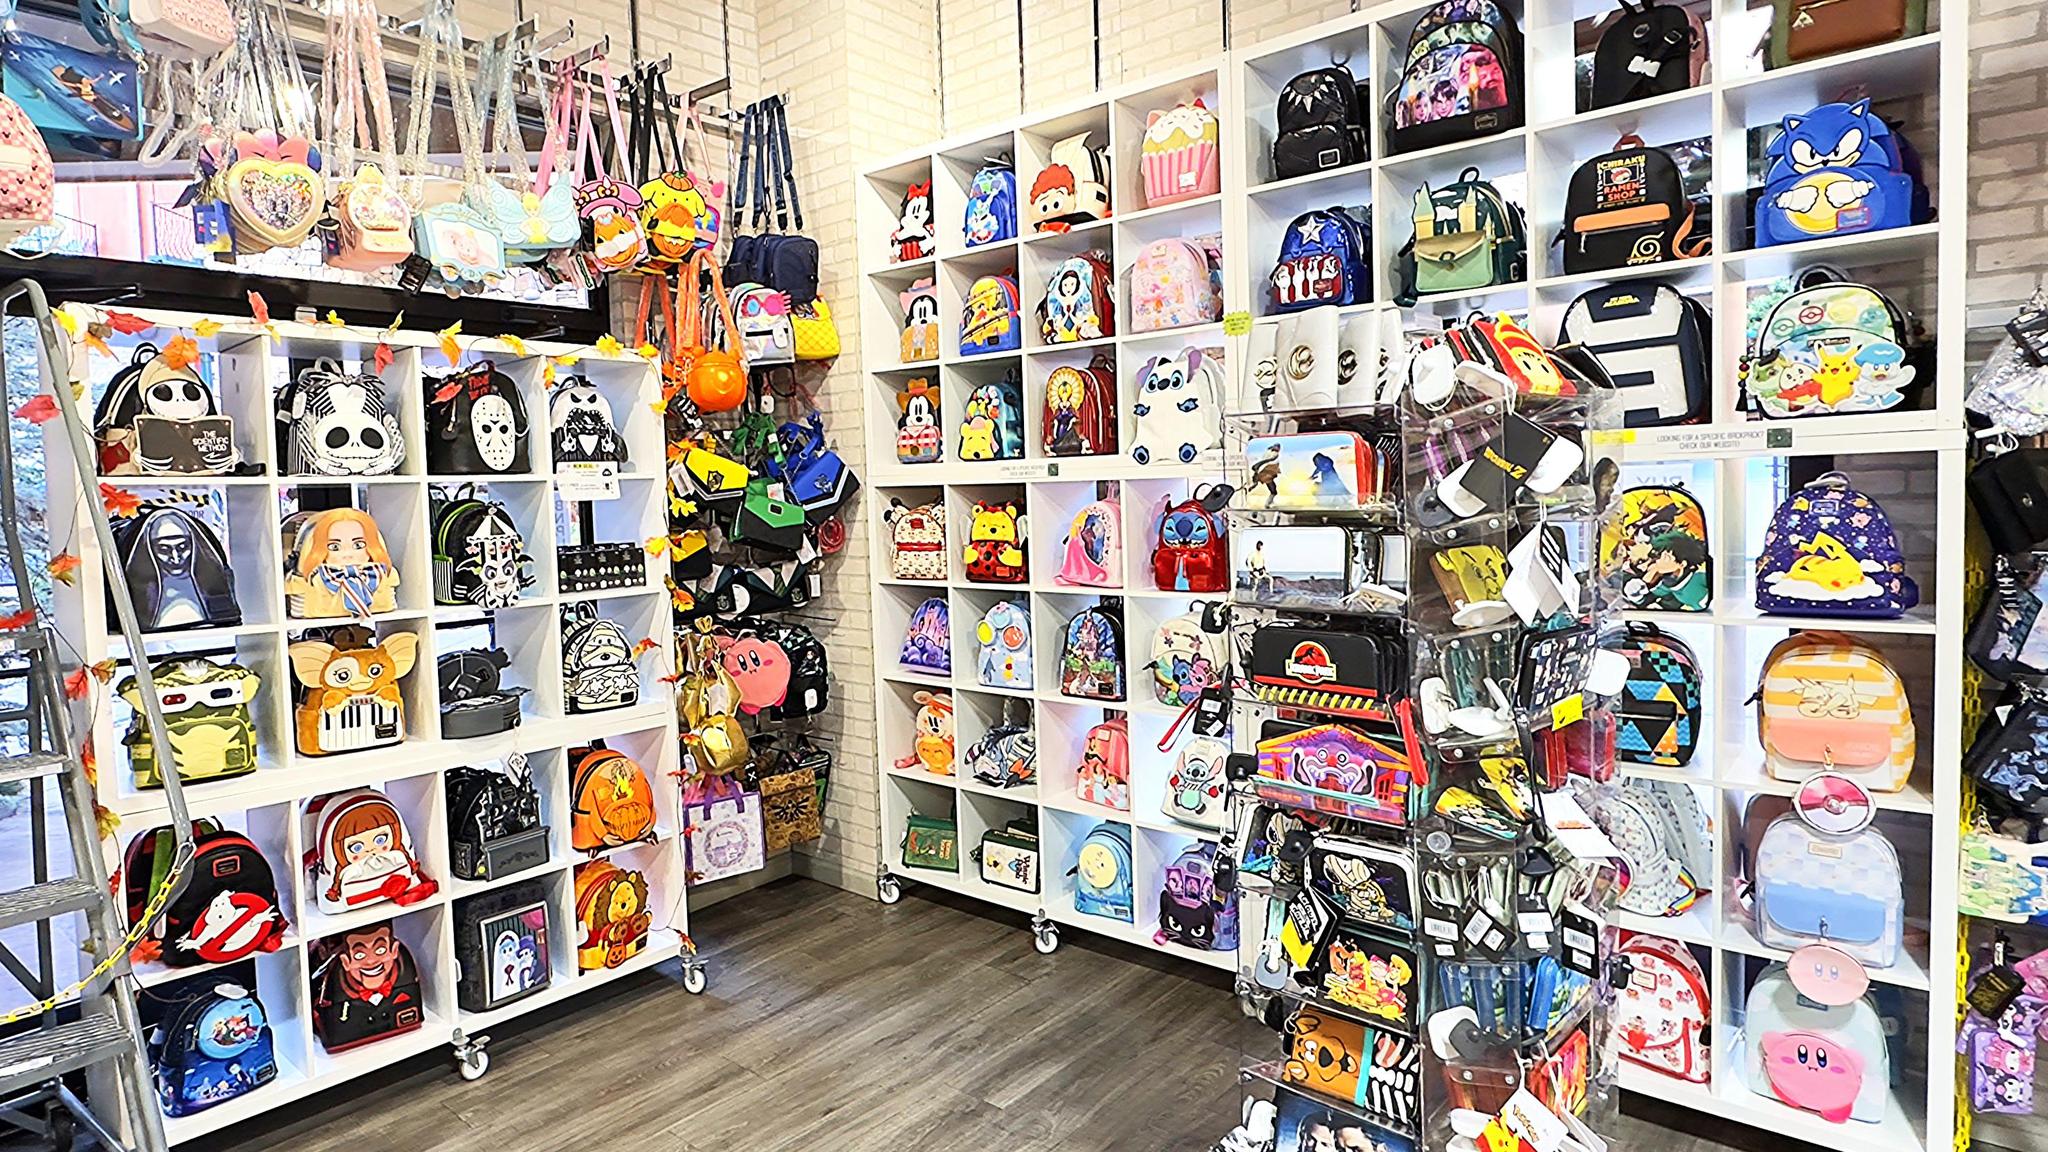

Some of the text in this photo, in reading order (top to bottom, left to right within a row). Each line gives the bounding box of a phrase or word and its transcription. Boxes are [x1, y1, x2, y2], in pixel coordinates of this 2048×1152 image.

[1597, 155, 1646, 169] ICHIRAKU
[1604, 182, 1640, 194] RAMEN
[1607, 190, 1636, 201] SHOP
[202, 430, 217, 438] THE
[198, 444, 227, 452] METHOD
